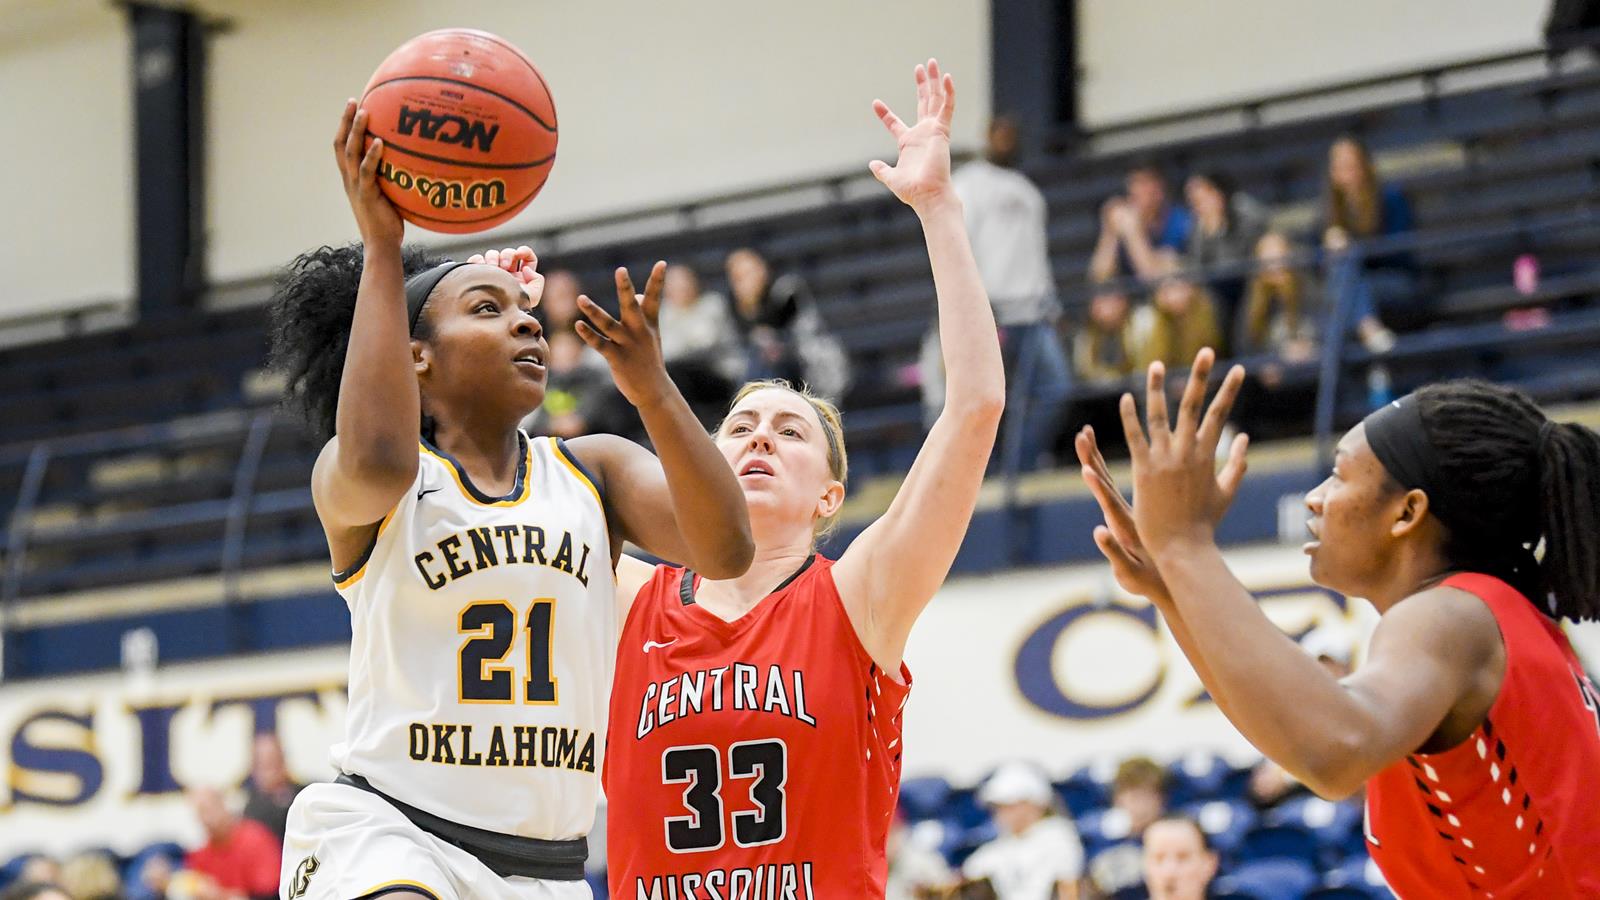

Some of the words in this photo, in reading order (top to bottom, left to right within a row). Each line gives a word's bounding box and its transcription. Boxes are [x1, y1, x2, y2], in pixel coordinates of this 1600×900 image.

[396, 105, 500, 153] NCAA
[377, 162, 507, 209] Wilson
[414, 524, 591, 591] CENTRAL
[457, 597, 559, 706] 21
[636, 662, 816, 740] CENTRAL
[408, 722, 595, 773] OKLAHOMA
[661, 738, 788, 854] 33
[635, 862, 814, 900] MISSOURI
